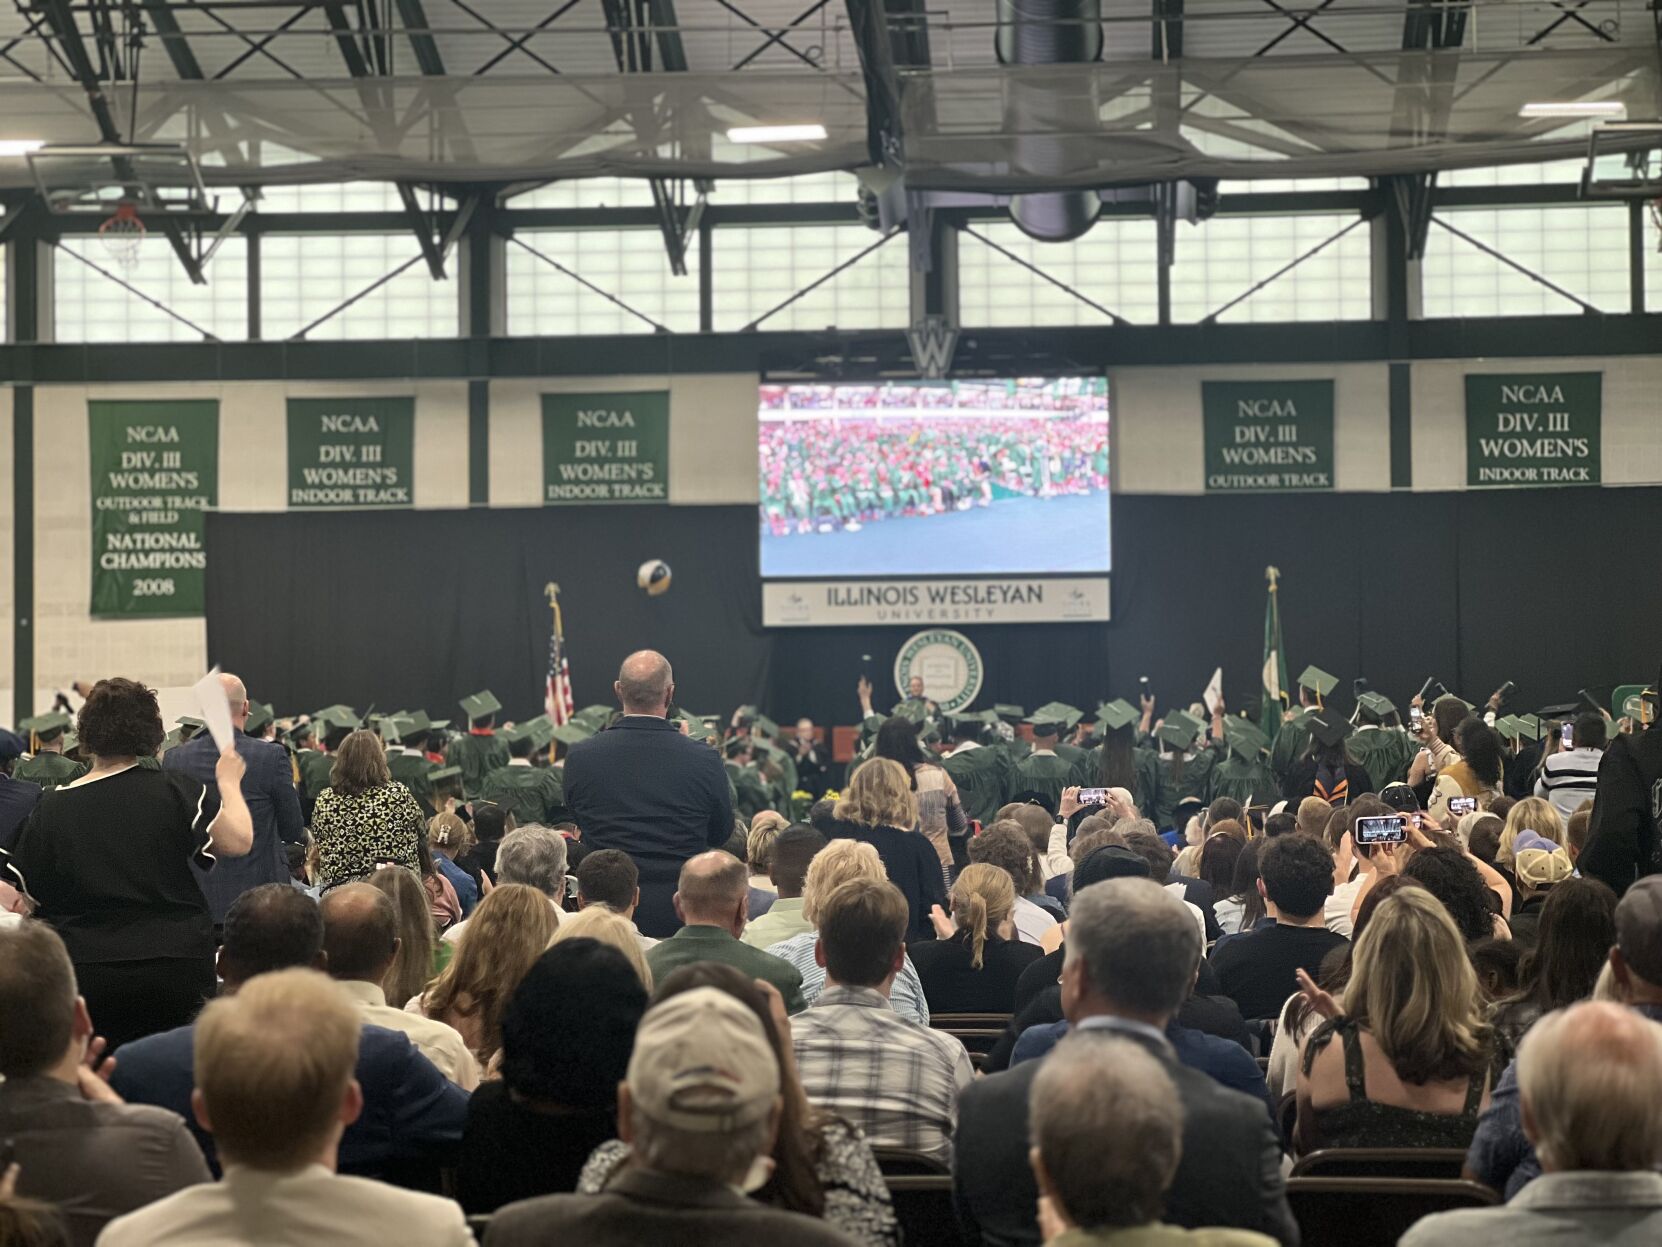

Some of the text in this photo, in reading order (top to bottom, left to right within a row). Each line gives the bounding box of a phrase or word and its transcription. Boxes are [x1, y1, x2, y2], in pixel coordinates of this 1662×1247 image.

[1500, 385, 1565, 404] NCAA
[1237, 399, 1297, 418] NCAA
[320, 414, 380, 433] NCAA
[576, 410, 635, 428] NCAA
[1497, 412, 1570, 433] DIV. III
[125, 425, 180, 443] NCAA
[1234, 424, 1297, 443] DIV. III
[318, 444, 382, 463] DIV. III
[574, 439, 637, 458] DIV. III
[1221, 446, 1318, 466] WOMEN'S
[1480, 438, 1589, 458] WOMEN'S
[121, 450, 182, 470] DIV. III
[108, 471, 199, 490] WOMEN'S
[302, 466, 399, 486] WOMEN'S
[559, 462, 654, 481] WOMEN'S
[1208, 473, 1329, 488] OUTDOOR TRACK
[1479, 466, 1590, 482] INDOOR TRACK
[291, 486, 409, 504] INDOOR TRACK
[547, 482, 664, 499] INDOOR TRACK
[95, 495, 209, 511] OUTDOOR TRACK
[141, 510, 180, 524] FIELD
[106, 531, 202, 551] NATIONAL
[100, 551, 207, 571] CHAMPIONS
[826, 584, 1043, 607] ILLINOIS WESLEYAN
[876, 607, 996, 620] UNIVERSITY
